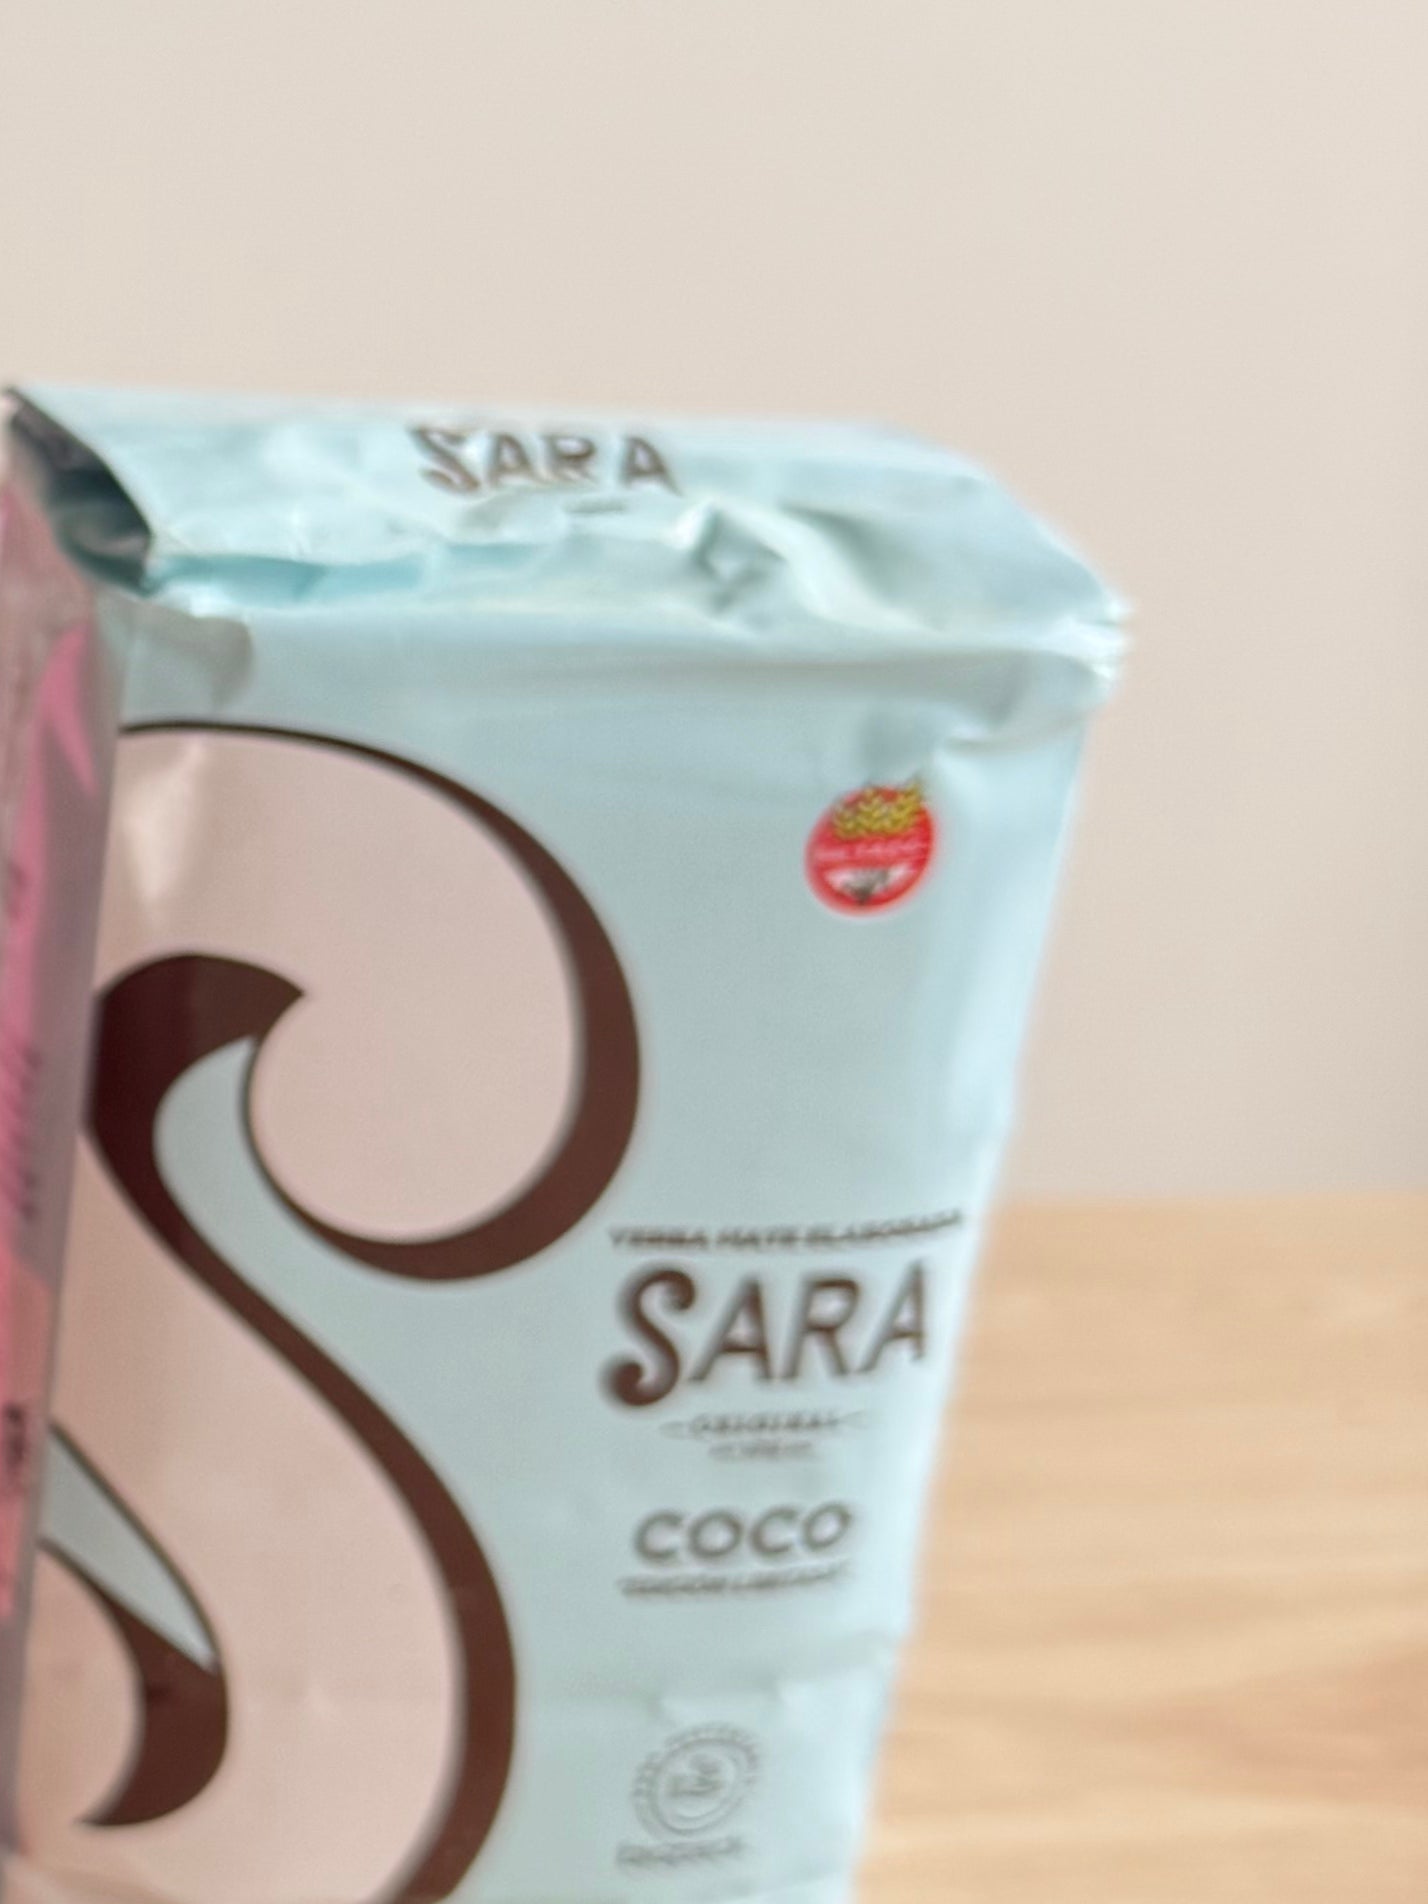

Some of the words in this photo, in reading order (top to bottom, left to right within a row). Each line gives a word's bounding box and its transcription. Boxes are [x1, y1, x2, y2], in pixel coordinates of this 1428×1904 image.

[406, 424, 682, 496] SARA
[603, 1259, 928, 1407] SARA
[633, 1501, 850, 1561] COCO
